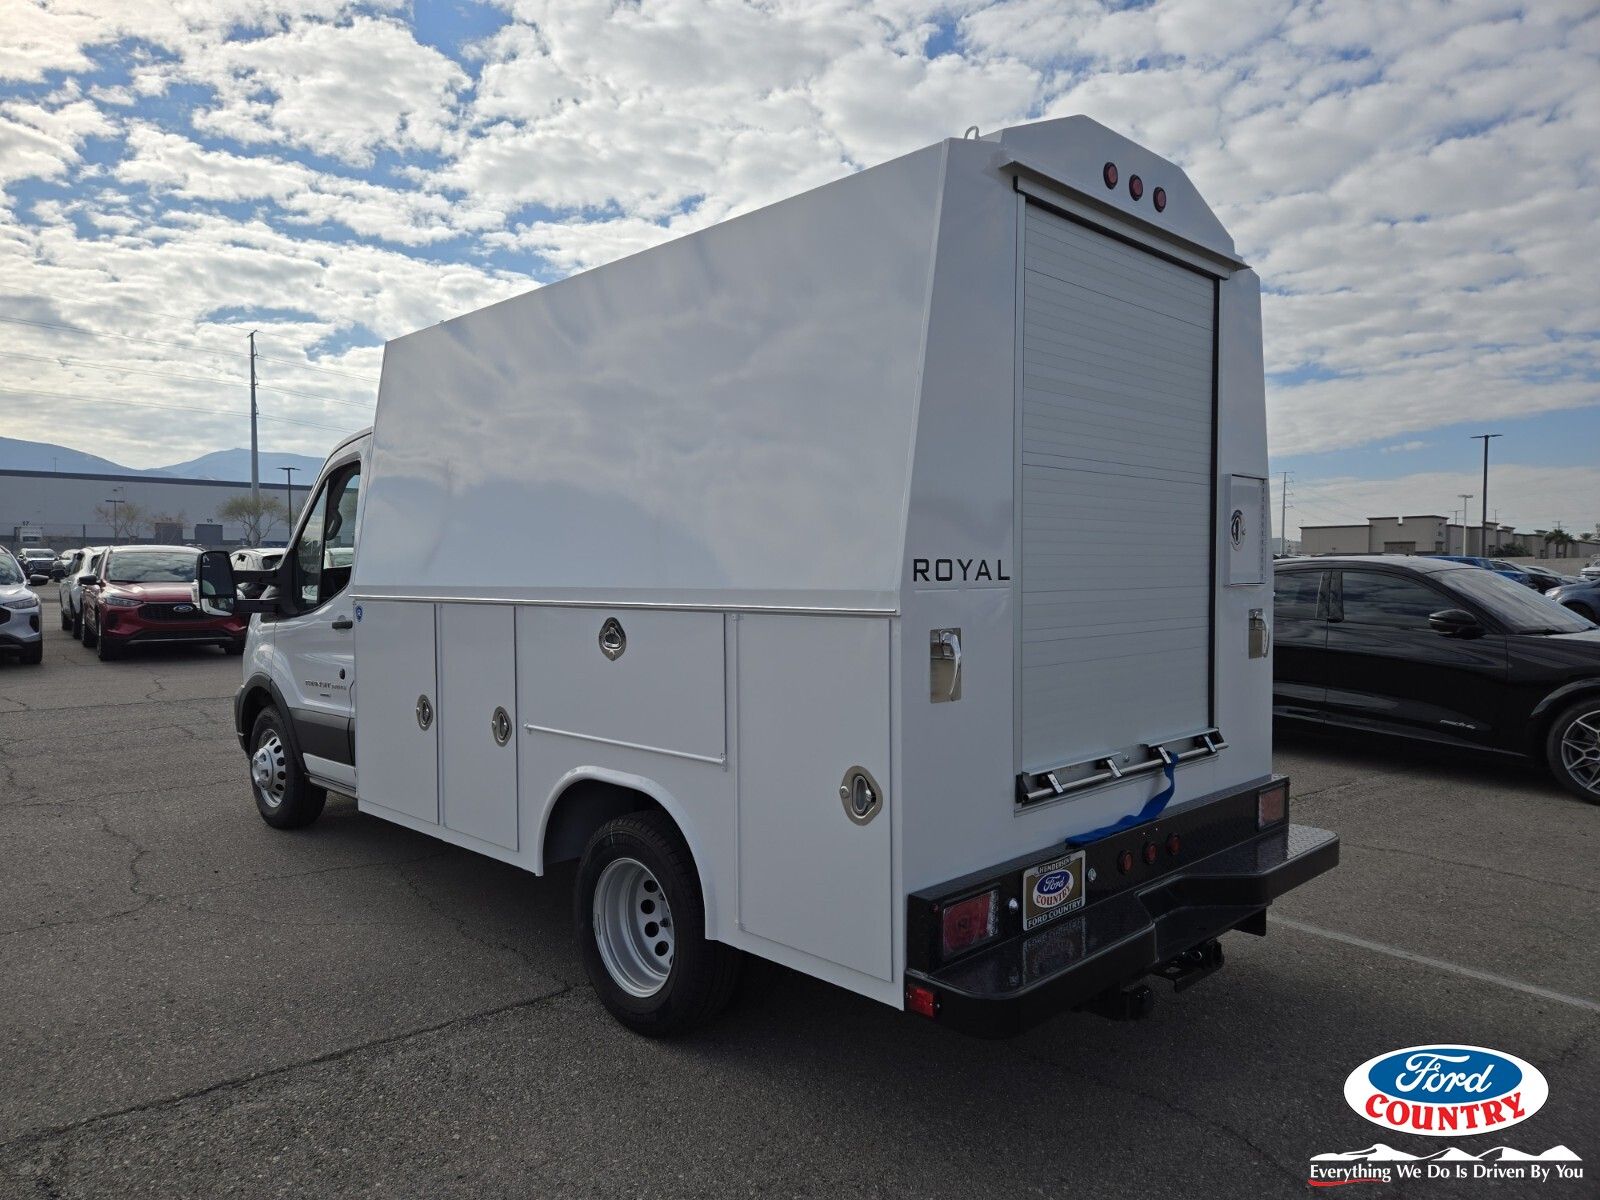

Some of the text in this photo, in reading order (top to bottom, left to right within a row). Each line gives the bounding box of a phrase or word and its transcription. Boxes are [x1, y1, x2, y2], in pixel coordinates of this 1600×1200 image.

[913, 559, 1010, 582] ROYAL
[1039, 857, 1071, 873] HENDERSON
[1043, 875, 1065, 892] Ford
[1036, 885, 1071, 906] COUNTRY
[1048, 899, 1081, 919] COUNTRY
[1028, 914, 1048, 928] FORD
